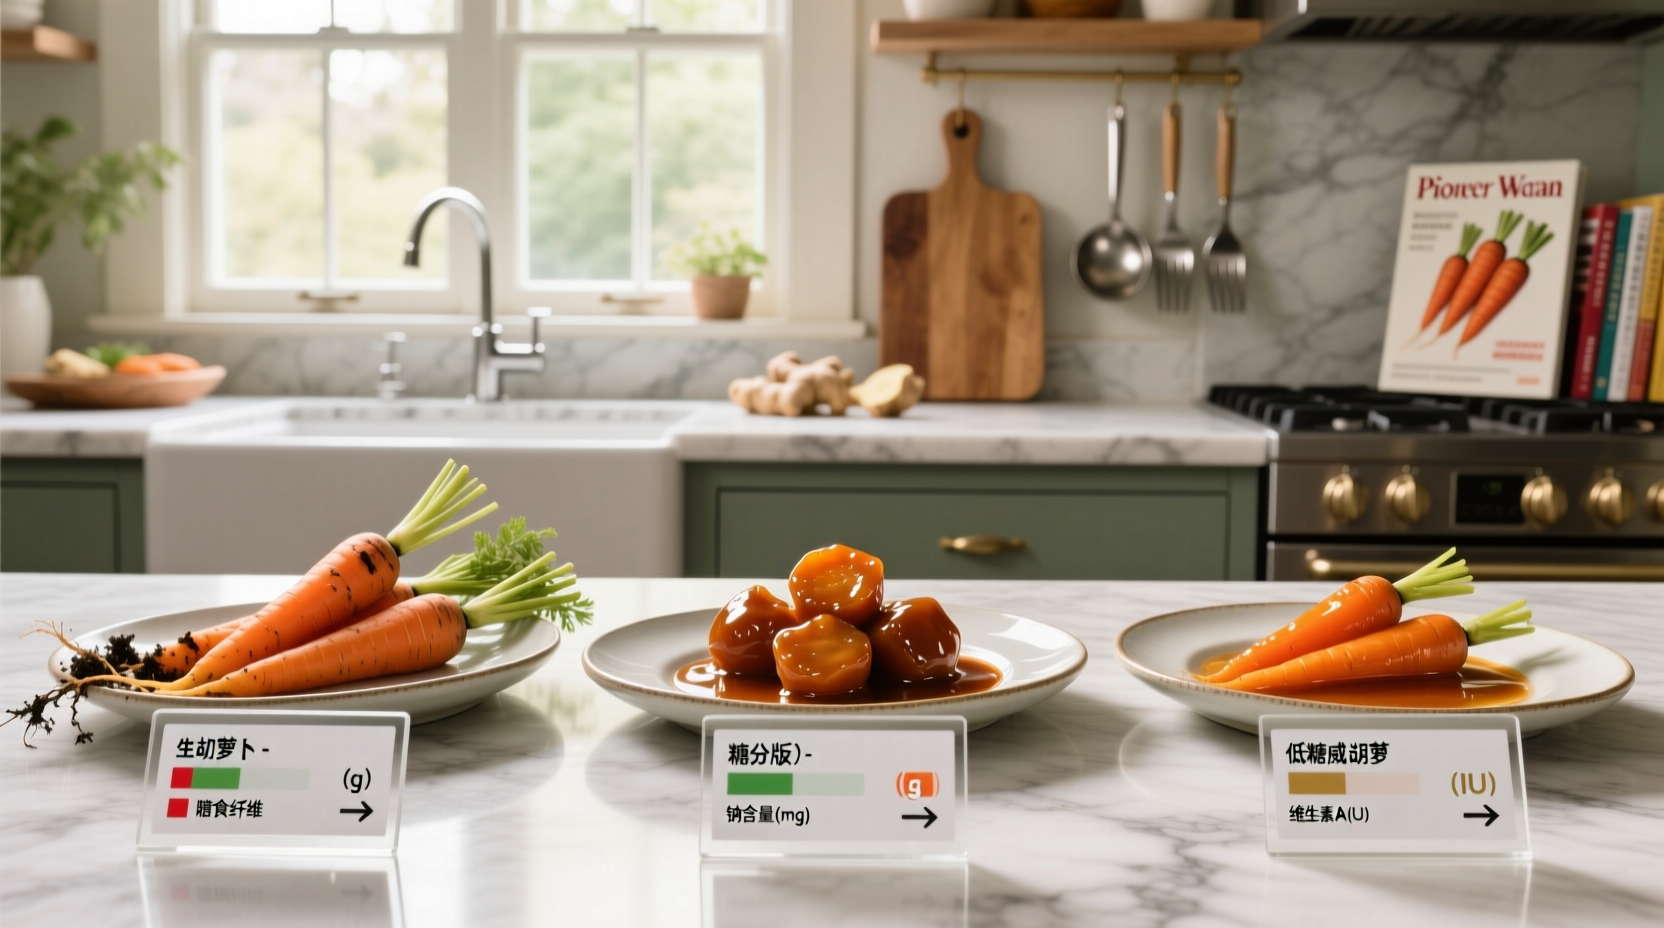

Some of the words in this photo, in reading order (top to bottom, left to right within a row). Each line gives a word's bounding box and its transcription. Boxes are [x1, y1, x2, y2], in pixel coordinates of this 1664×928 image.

[342, 767, 372, 794] (g)
[1451, 771, 1497, 798] (IU)
[726, 804, 810, 826] 钠含量(mg)
